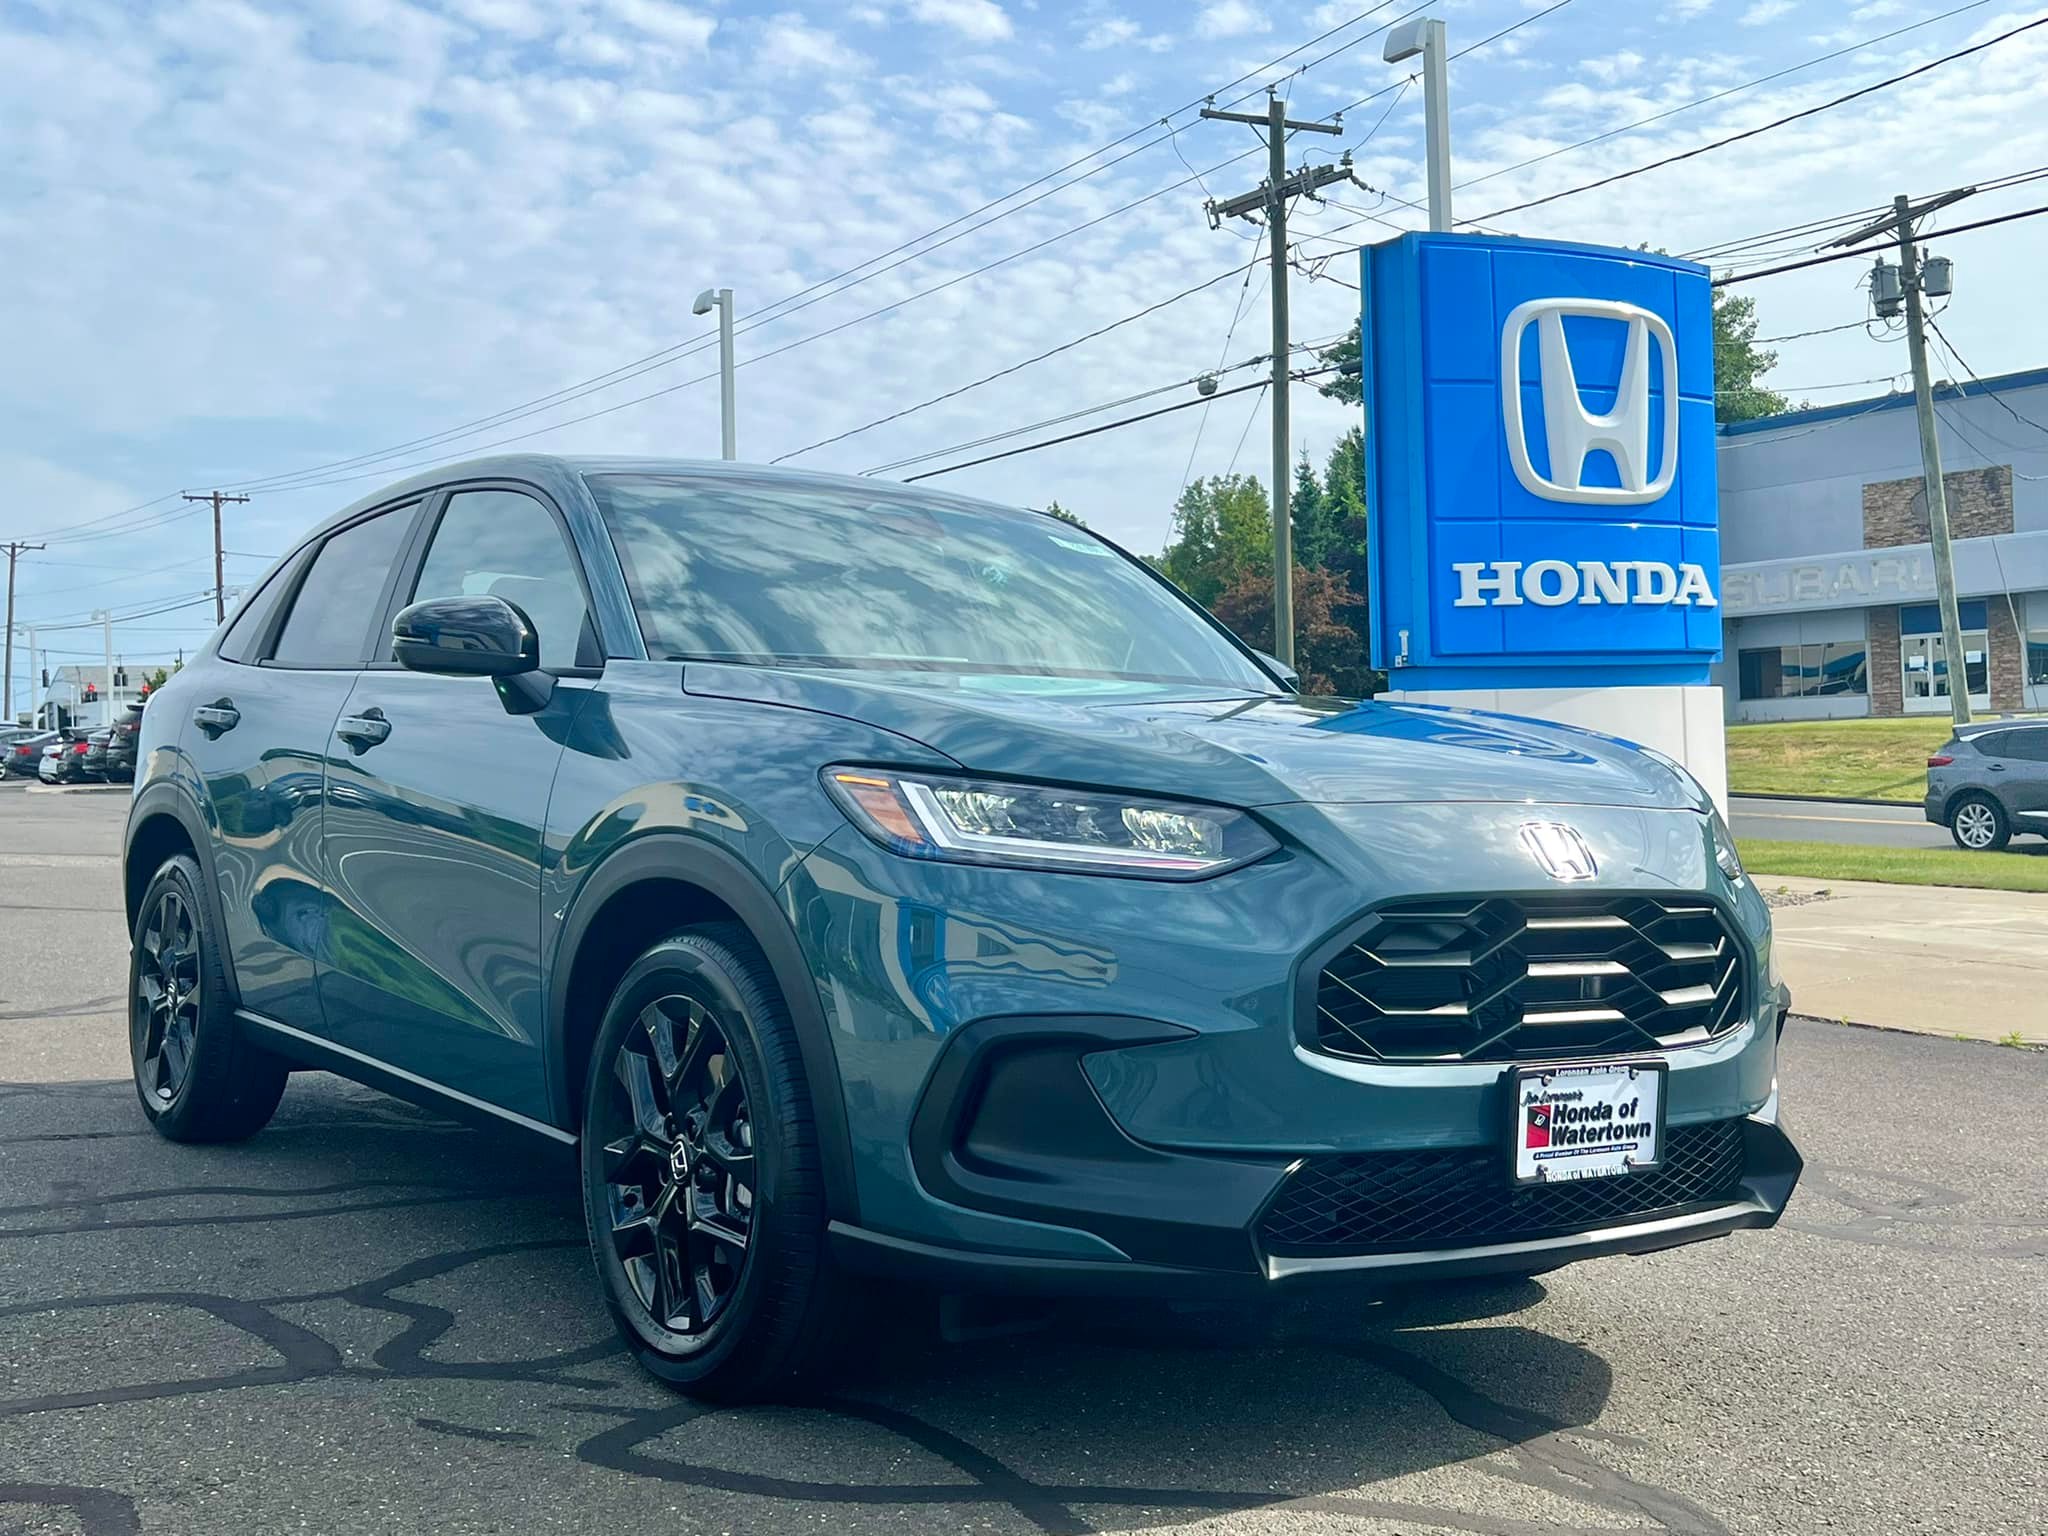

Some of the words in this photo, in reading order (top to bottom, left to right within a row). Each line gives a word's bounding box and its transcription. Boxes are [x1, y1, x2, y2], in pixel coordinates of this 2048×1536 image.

[1452, 560, 1718, 607] HONDA
[1552, 1100, 1612, 1125] Honda
[1619, 1097, 1639, 1118] of
[1551, 1122, 1651, 1147] Watertown
